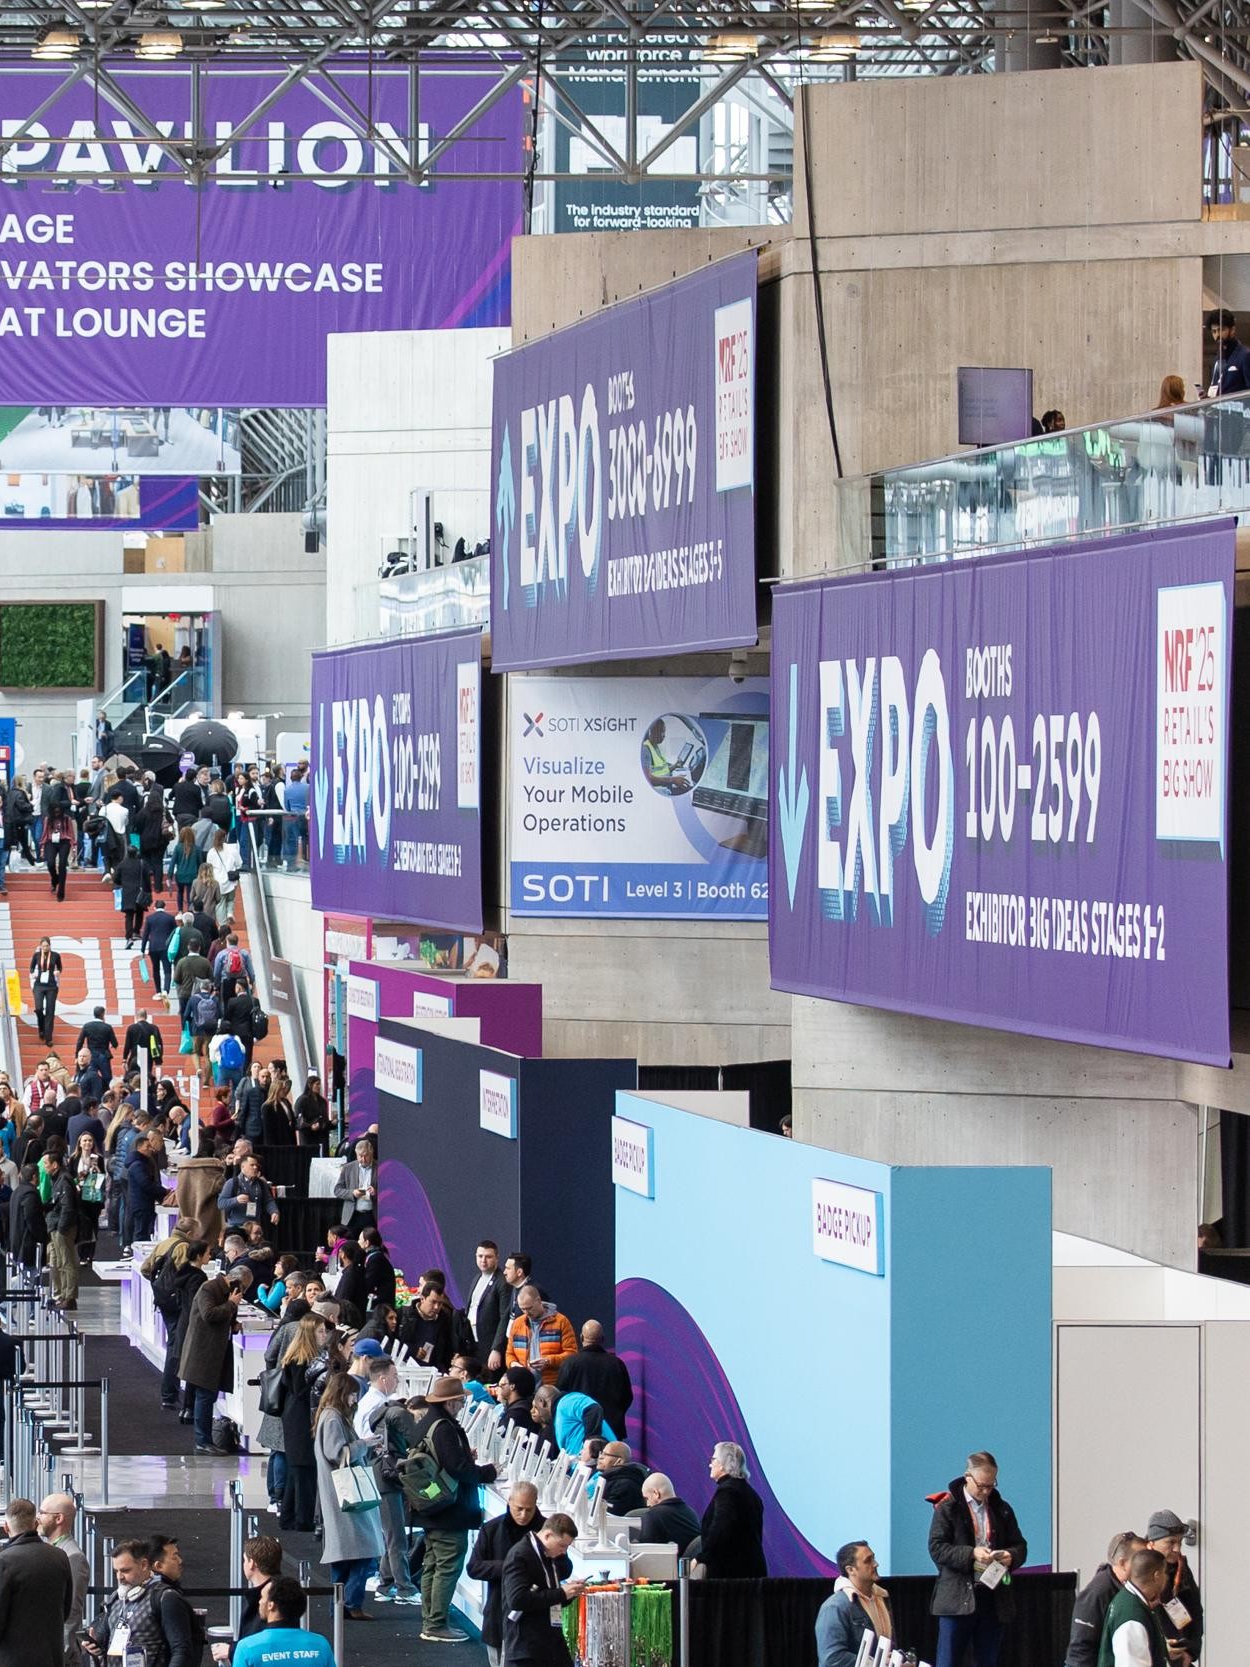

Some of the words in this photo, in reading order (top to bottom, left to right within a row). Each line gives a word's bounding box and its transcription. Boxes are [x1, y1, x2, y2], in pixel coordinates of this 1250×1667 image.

[569, 66, 700, 84] Manaement
[2, 119, 429, 187] PAVLION
[566, 204, 588, 216] The
[591, 204, 641, 219] industry
[644, 204, 699, 217] standard
[573, 216, 590, 227] for
[594, 216, 691, 228] forward-looking
[165, 261, 384, 293] SHOWCASE
[56, 308, 206, 339] LOUNGE
[607, 404, 698, 521] 3000-6999
[519, 383, 602, 586] EXPO
[965, 643, 1013, 699] BOOTHS
[1164, 628, 1194, 693] NRF
[548, 717, 579, 732] SOTI
[1163, 704, 1214, 746] RETAIL'S
[331, 693, 392, 851] EXPO
[393, 733, 442, 812] 100-2599
[523, 756, 605, 776] Visualize
[818, 648, 950, 905] EXPO
[965, 710, 1102, 844] 100-2599
[1163, 759, 1180, 799] BIG
[1183, 759, 1214, 799] SHOW
[523, 785, 566, 804] Your
[571, 785, 634, 804] Mobile
[523, 813, 626, 835] Operations
[523, 874, 609, 902] SOTI
[626, 881, 668, 898] Level
[673, 881, 683, 898] 3
[697, 882, 746, 899] Booth
[966, 891, 1026, 947] EXHIBITOR
[1029, 896, 1049, 950] BIG
[1051, 898, 1089, 954] IDEAS
[1091, 901, 1141, 959] STAGES
[1143, 904, 1166, 961] 1-2
[817, 1202, 843, 1240] BADGE
[844, 1209, 871, 1248] PICKUP
[261, 1651, 291, 1662] EVENT
[293, 1650, 320, 1659] STAFF
